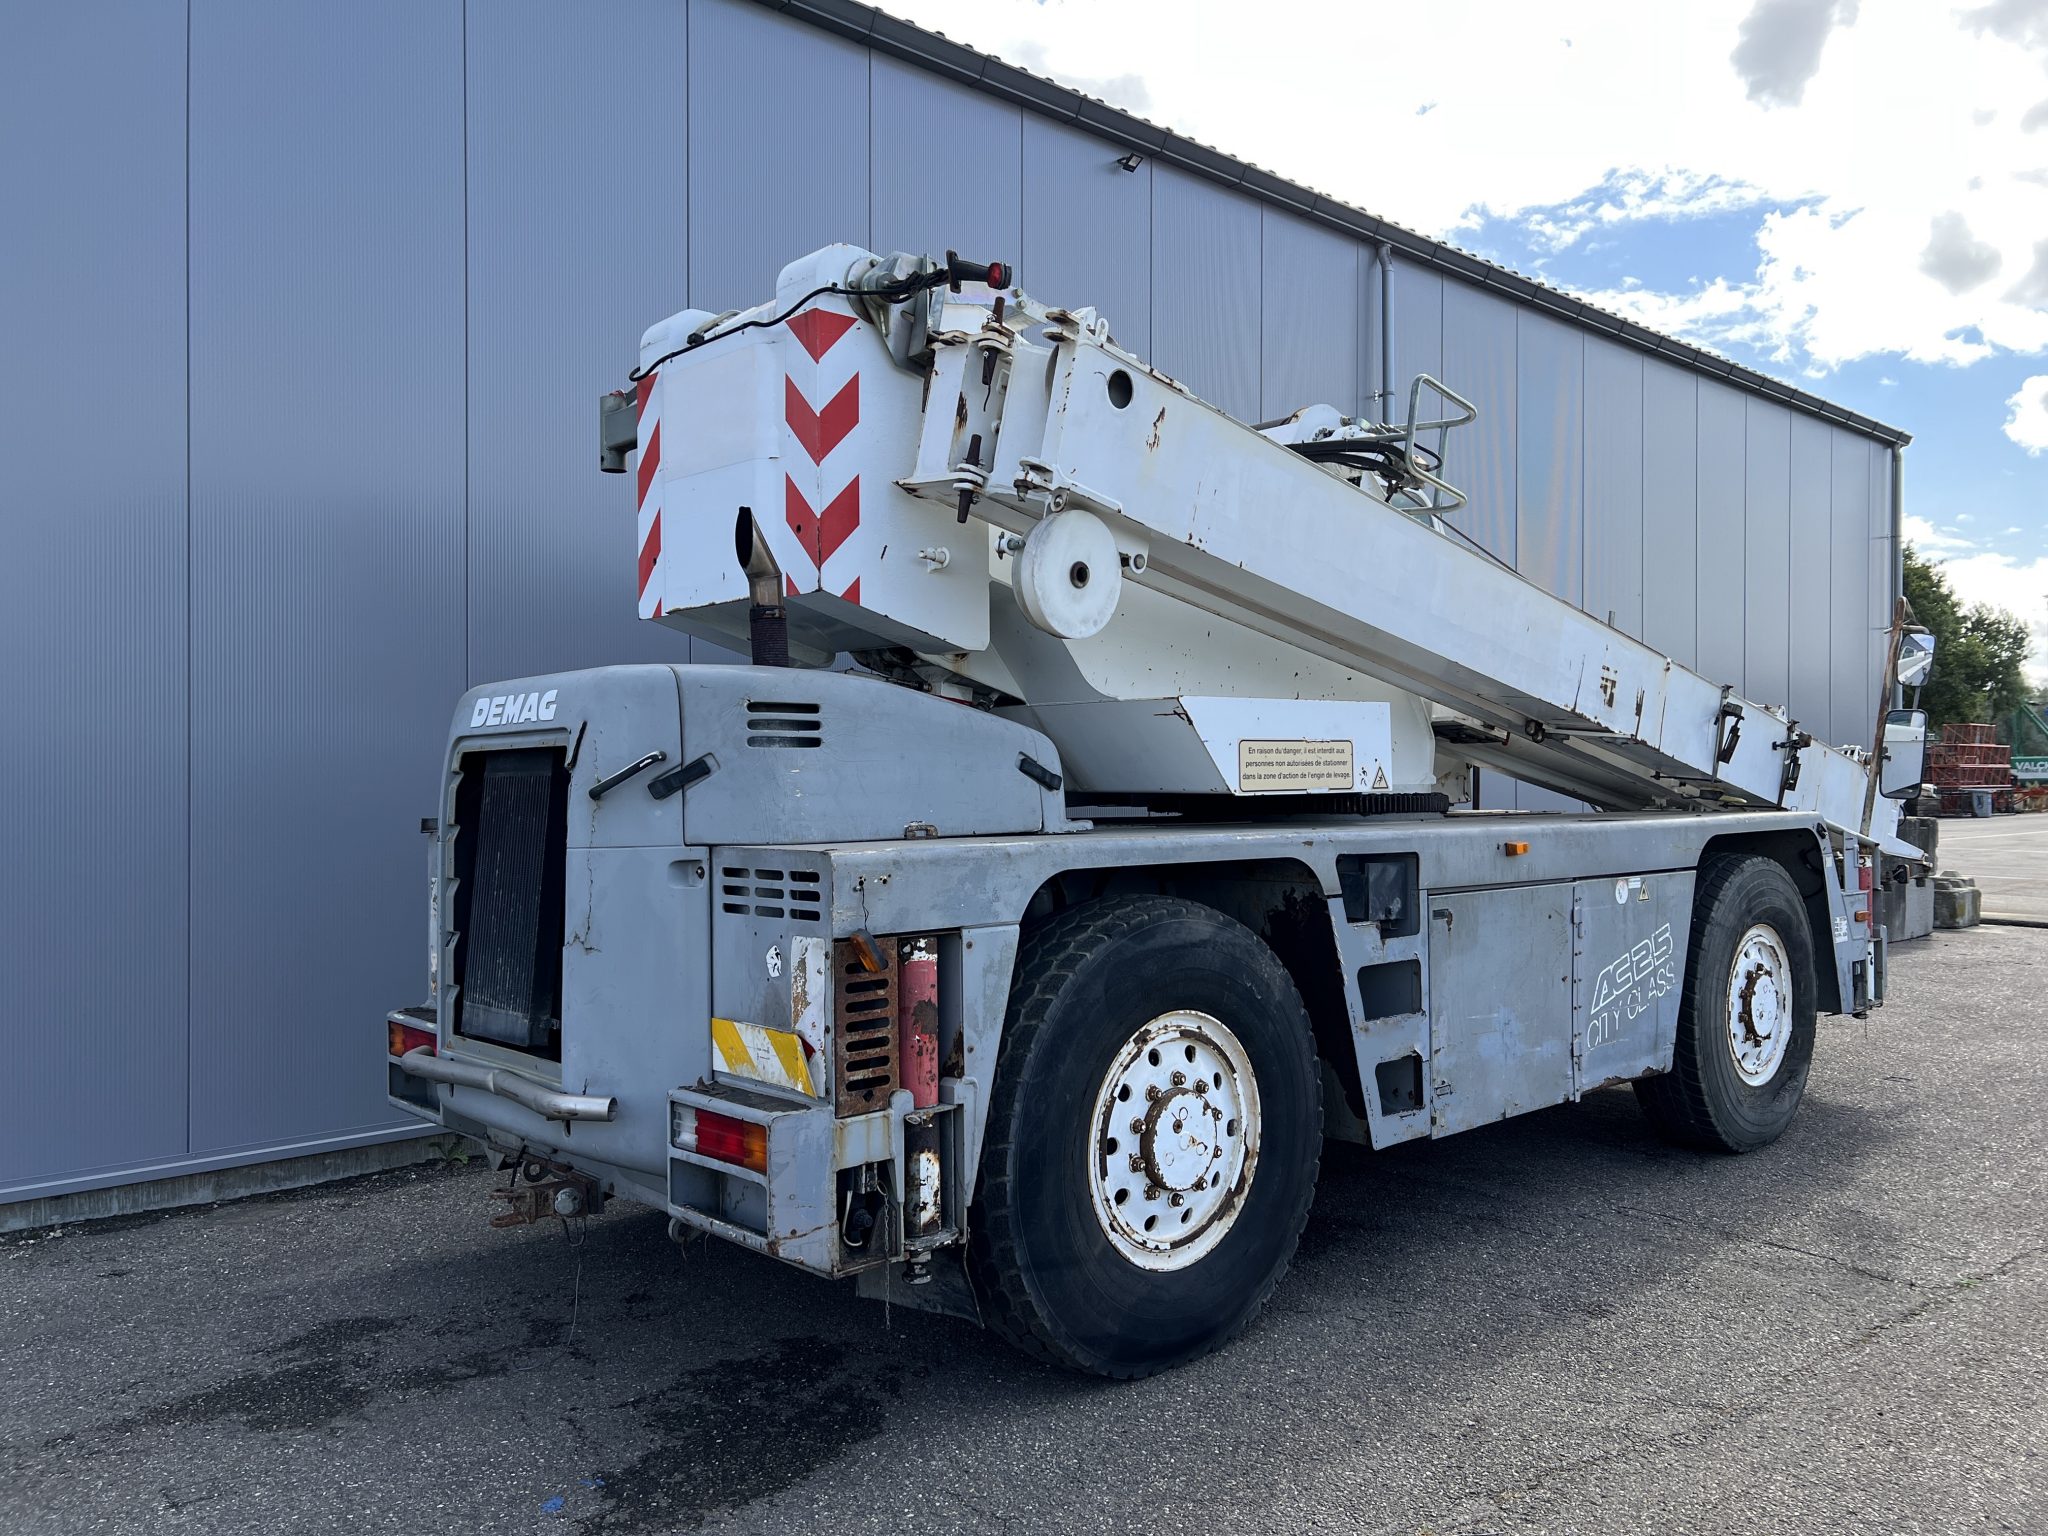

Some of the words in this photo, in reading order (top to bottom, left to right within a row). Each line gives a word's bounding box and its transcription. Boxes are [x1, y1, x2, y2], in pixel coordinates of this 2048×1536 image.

[470, 689, 558, 728] DEMAG
[1308, 772, 1324, 780] l'engin
[1628, 961, 1675, 1019] CLASS
